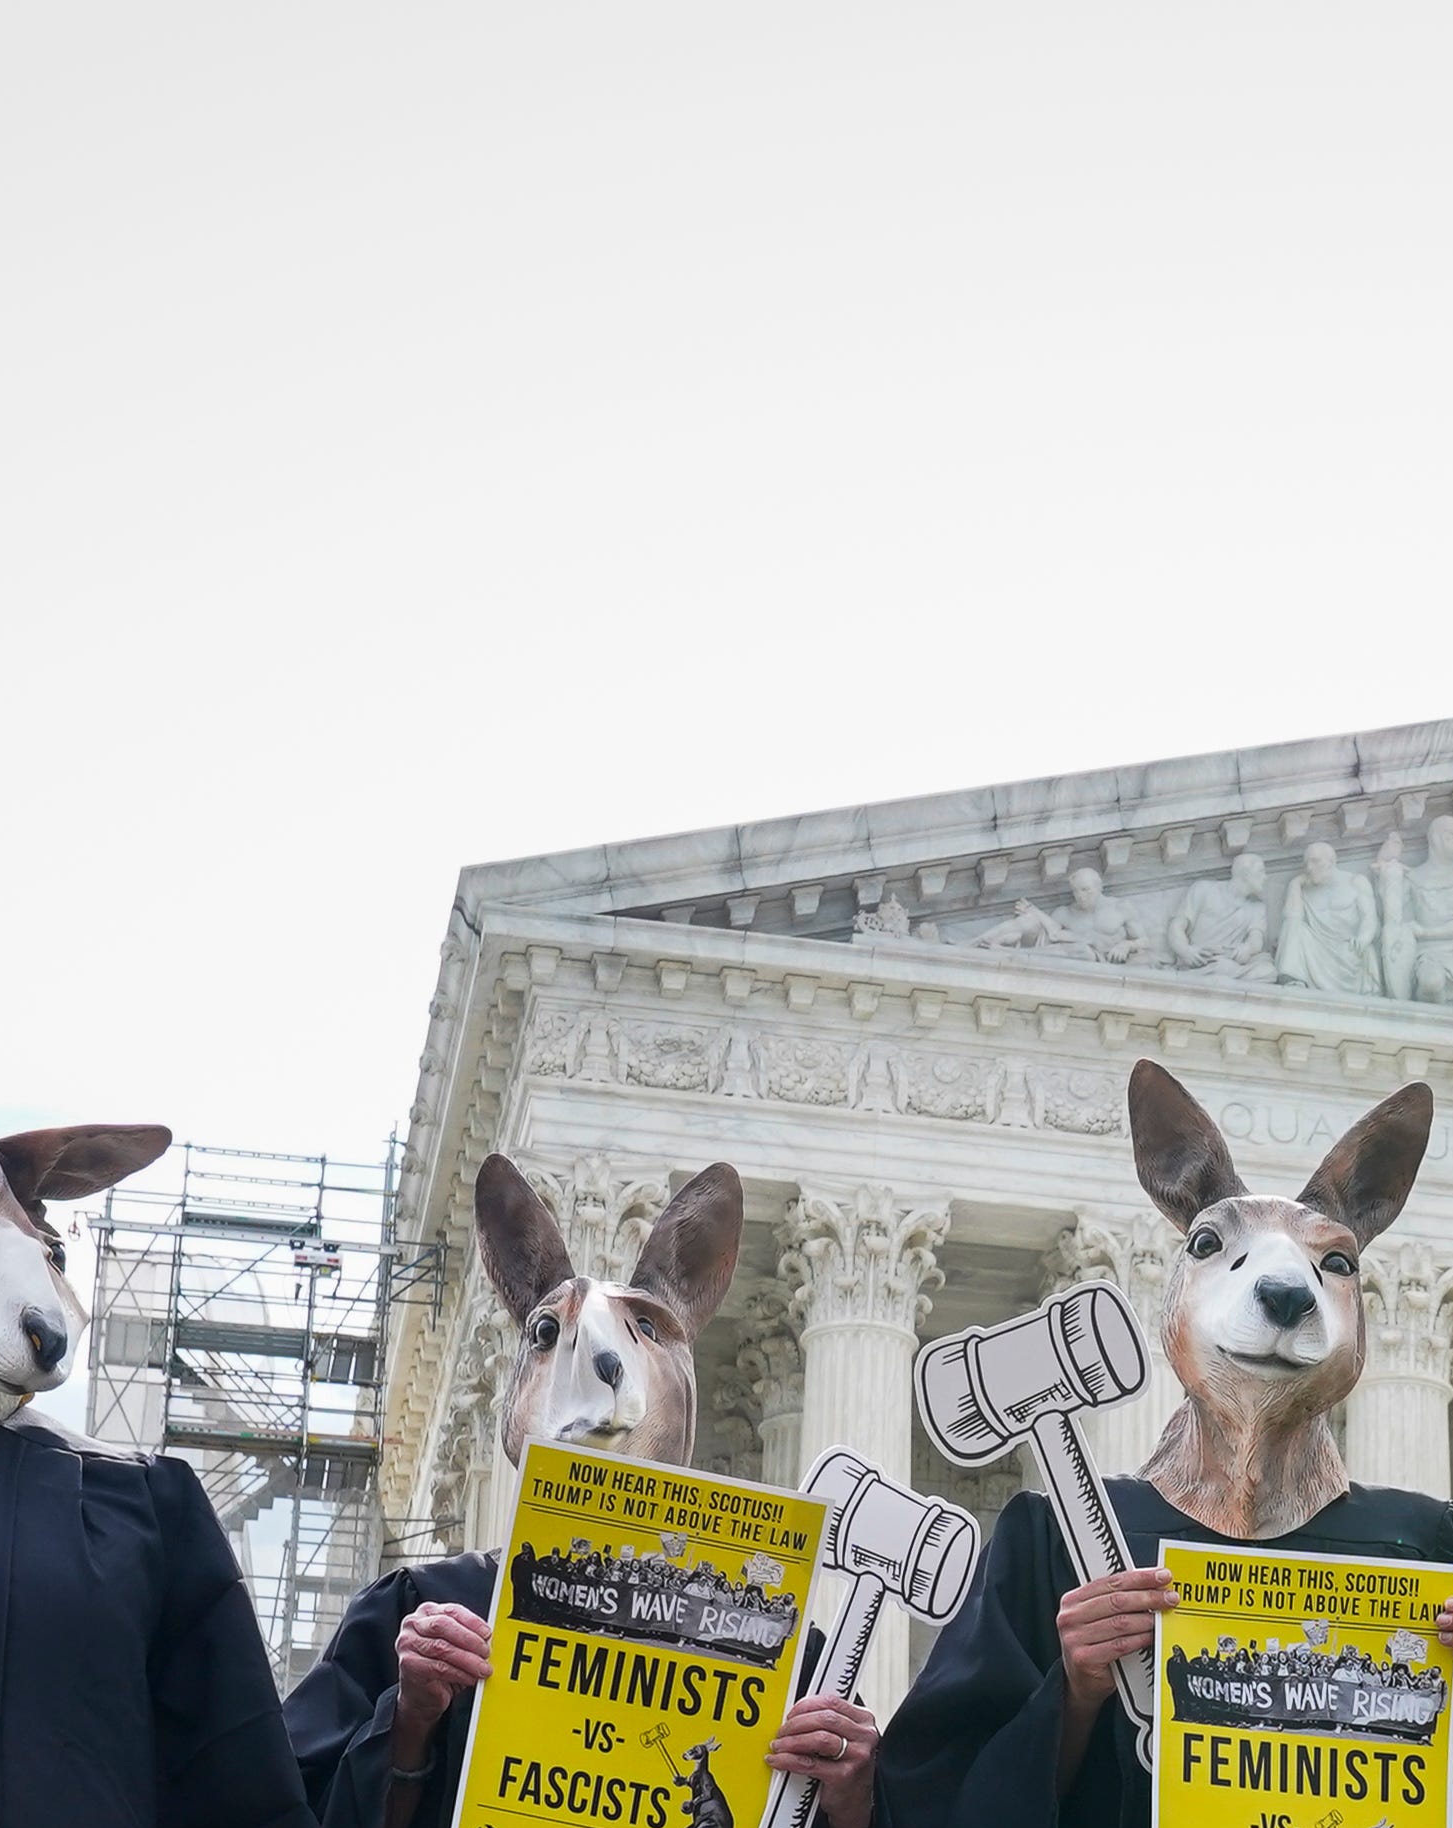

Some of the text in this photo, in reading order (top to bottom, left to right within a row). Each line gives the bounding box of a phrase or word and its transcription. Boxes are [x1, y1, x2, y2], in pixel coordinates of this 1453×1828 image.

[1219, 1101, 1338, 1146] QUA
[534, 1478, 807, 1550] TRUMP IS NOT ABOVE THE LAW
[569, 1462, 784, 1523] NOW HEAR THIS, SCOTUS!!
[1206, 1561, 1419, 1597] NOW HEAR THIS, SCOTUS!!
[1239, 1588, 1254, 1607] IS
[1263, 1590, 1296, 1610] NOT
[1304, 1594, 1360, 1615] ABOVE
[1369, 1599, 1401, 1619] THE
[531, 1573, 778, 1648] WOMEN'S WAVE RISING
[510, 1632, 764, 1727] FEMINISTS
[1188, 1675, 1434, 1725] WOMEN'S WAVE RISING
[572, 1718, 624, 1753] -VS-
[499, 1756, 670, 1828] FASCISTS
[1183, 1733, 1425, 1805] FEMINISTS
